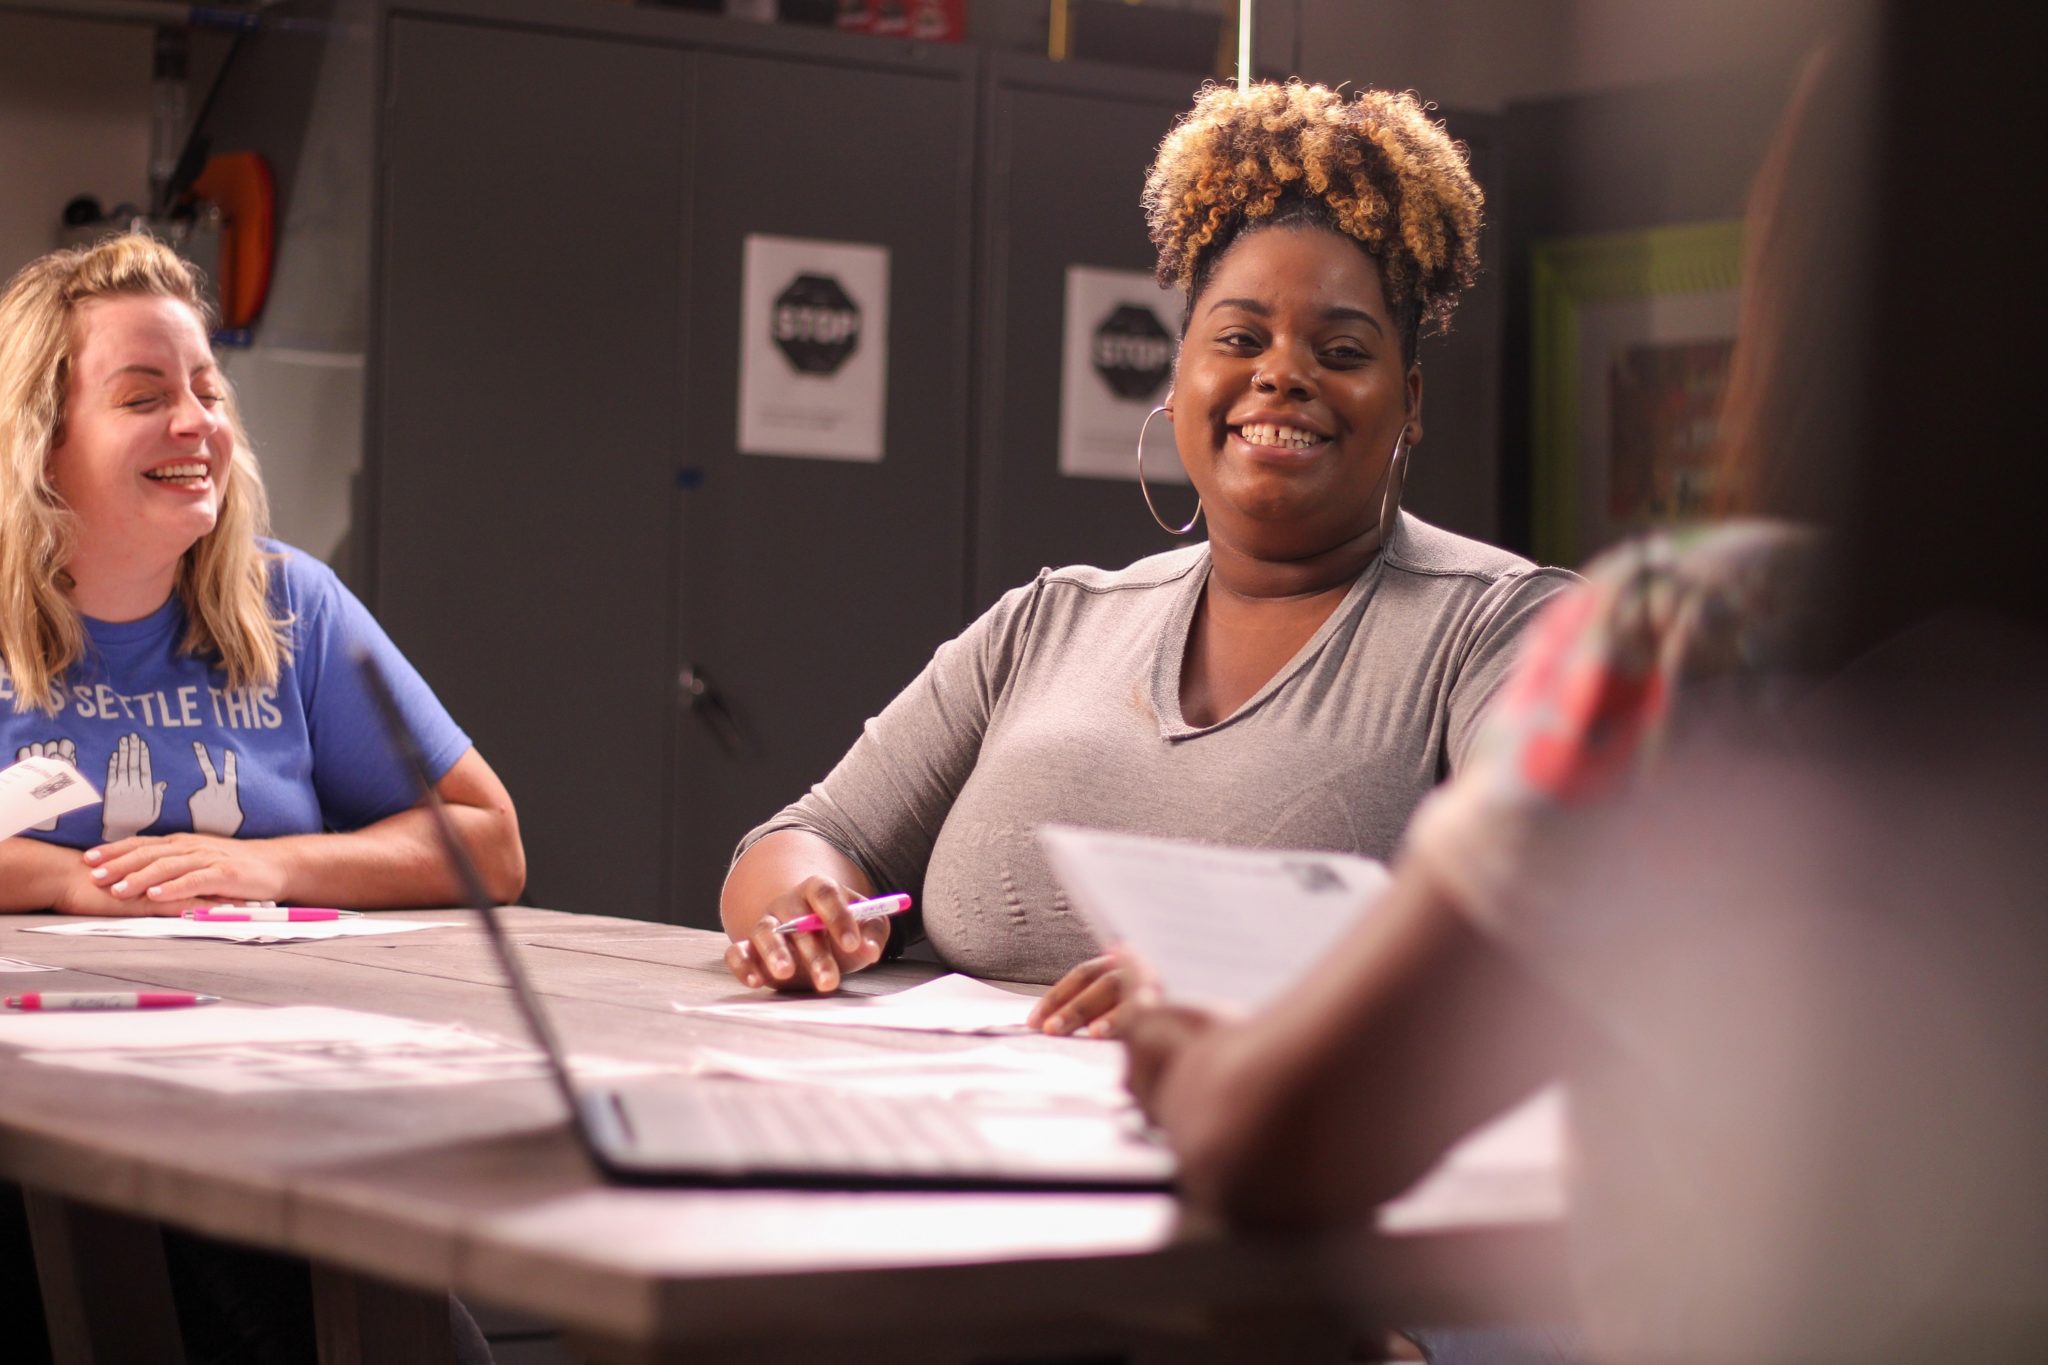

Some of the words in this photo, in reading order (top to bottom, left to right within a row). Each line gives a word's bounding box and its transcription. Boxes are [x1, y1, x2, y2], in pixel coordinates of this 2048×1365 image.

[776, 305, 858, 343] STOP
[1097, 334, 1168, 370] STOP
[73, 683, 203, 728] SETTLE
[208, 686, 282, 729] THIS
